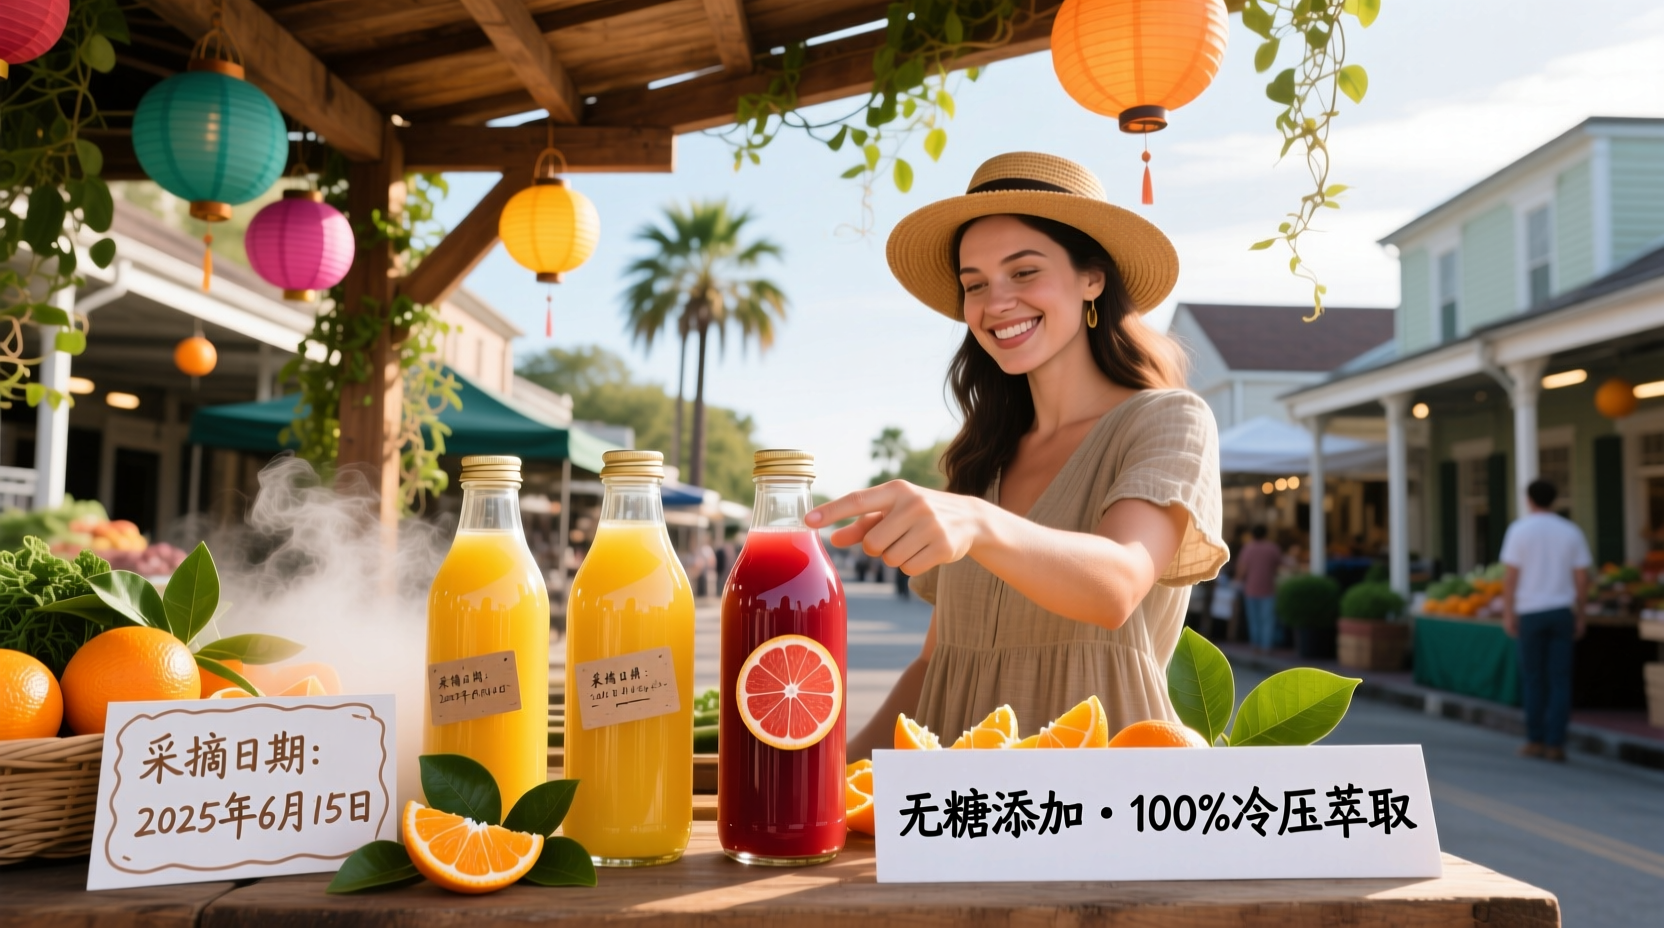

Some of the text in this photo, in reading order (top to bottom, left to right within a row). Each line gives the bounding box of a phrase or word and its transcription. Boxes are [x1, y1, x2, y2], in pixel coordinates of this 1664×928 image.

[139, 730, 320, 784] 采摘日期：
[134, 790, 371, 840] 2025年6月15日
